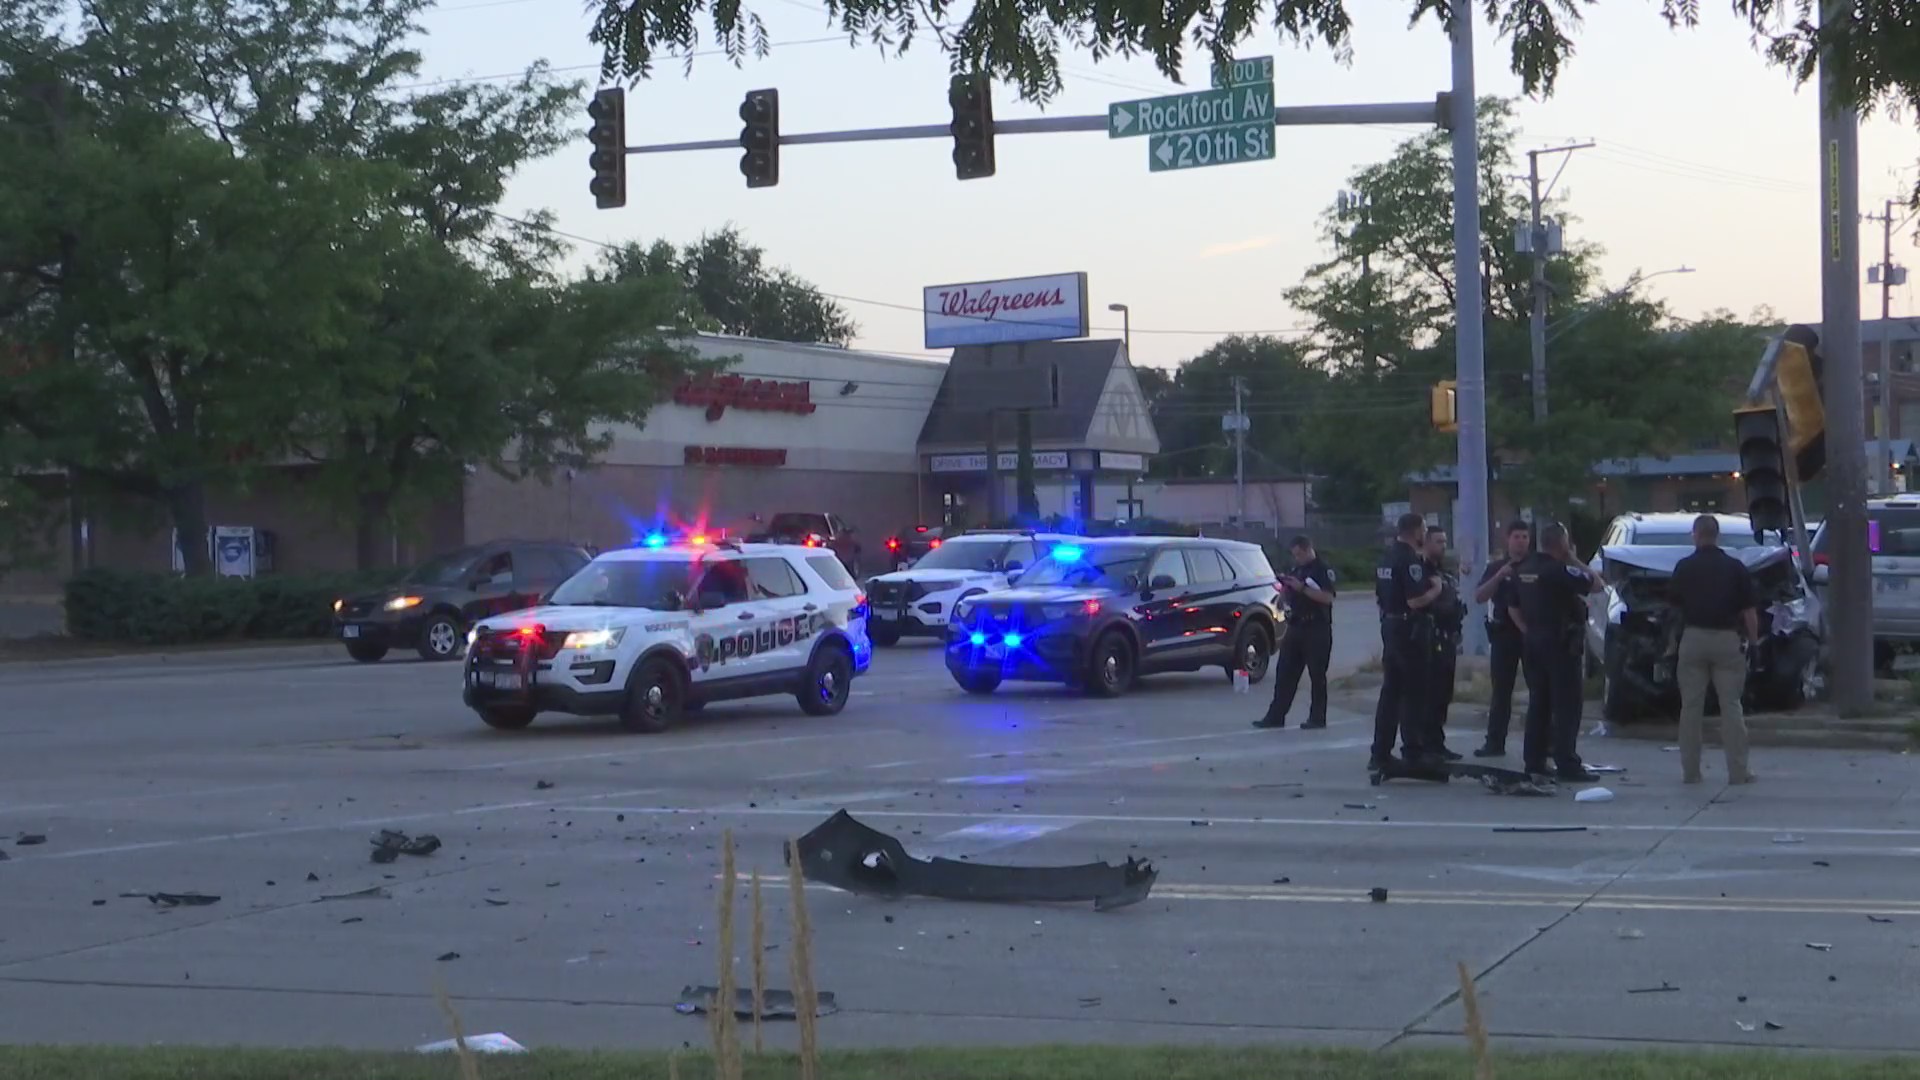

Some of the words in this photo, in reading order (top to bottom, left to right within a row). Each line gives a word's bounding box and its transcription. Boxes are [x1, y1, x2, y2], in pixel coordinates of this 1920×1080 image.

[1262, 58, 1273, 79] E
[1138, 92, 1234, 132] Rockford
[1242, 88, 1270, 119] Av
[1177, 130, 1238, 168] 20th
[1244, 127, 1269, 158] St
[939, 287, 1065, 322] Walgreens
[1001, 454, 1067, 468] PHMACY
[719, 613, 811, 666] POLICE
